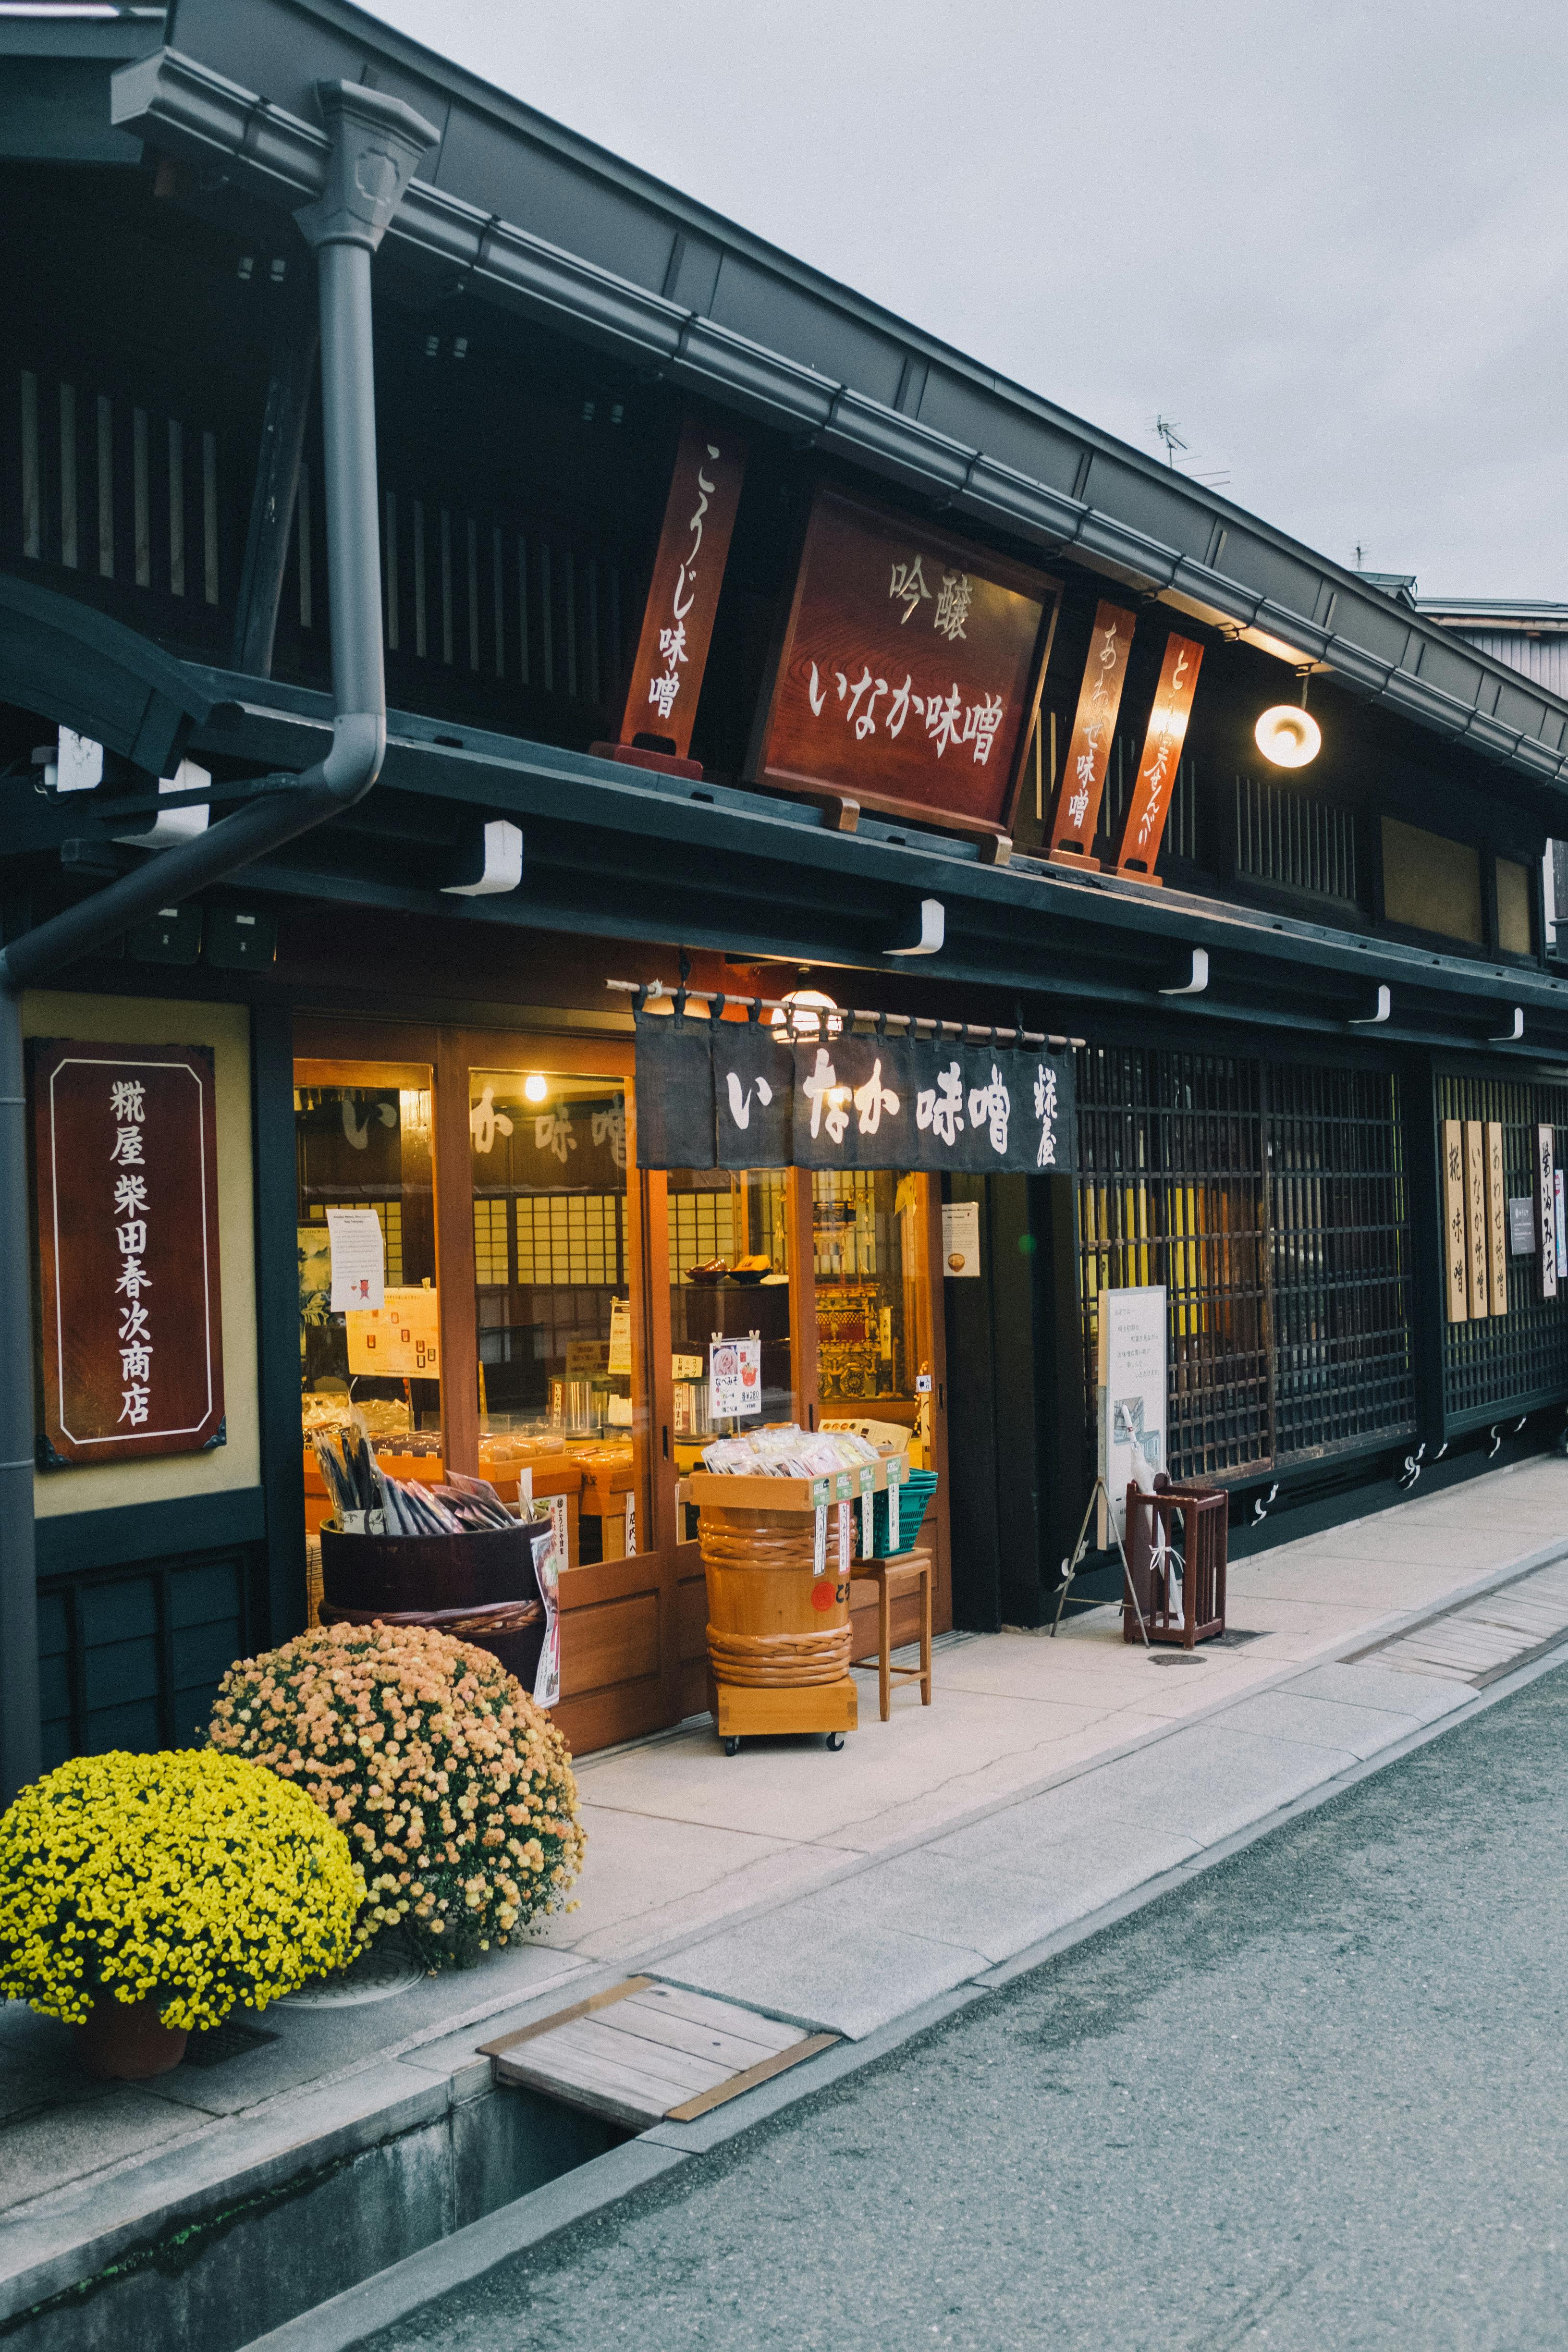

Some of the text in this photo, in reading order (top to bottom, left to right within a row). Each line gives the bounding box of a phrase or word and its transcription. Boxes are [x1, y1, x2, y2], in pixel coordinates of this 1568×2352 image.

[649, 444, 720, 719] こうじ味噌
[889, 554, 973, 641] 吟醸
[809, 661, 1004, 766] いなか味噌
[726, 1048, 1010, 1155] いなか味噌
[1033, 1063, 1057, 1168] 糀屋
[110, 1080, 153, 1427] 糀屋柴田春次商店
[1449, 1142, 1462, 1294] 糀味噌
[1471, 1147, 1483, 1300] いなか味噌
[1493, 1143, 1503, 1298] あわせ味噌
[716, 1376, 737, 1386] なべみそ
